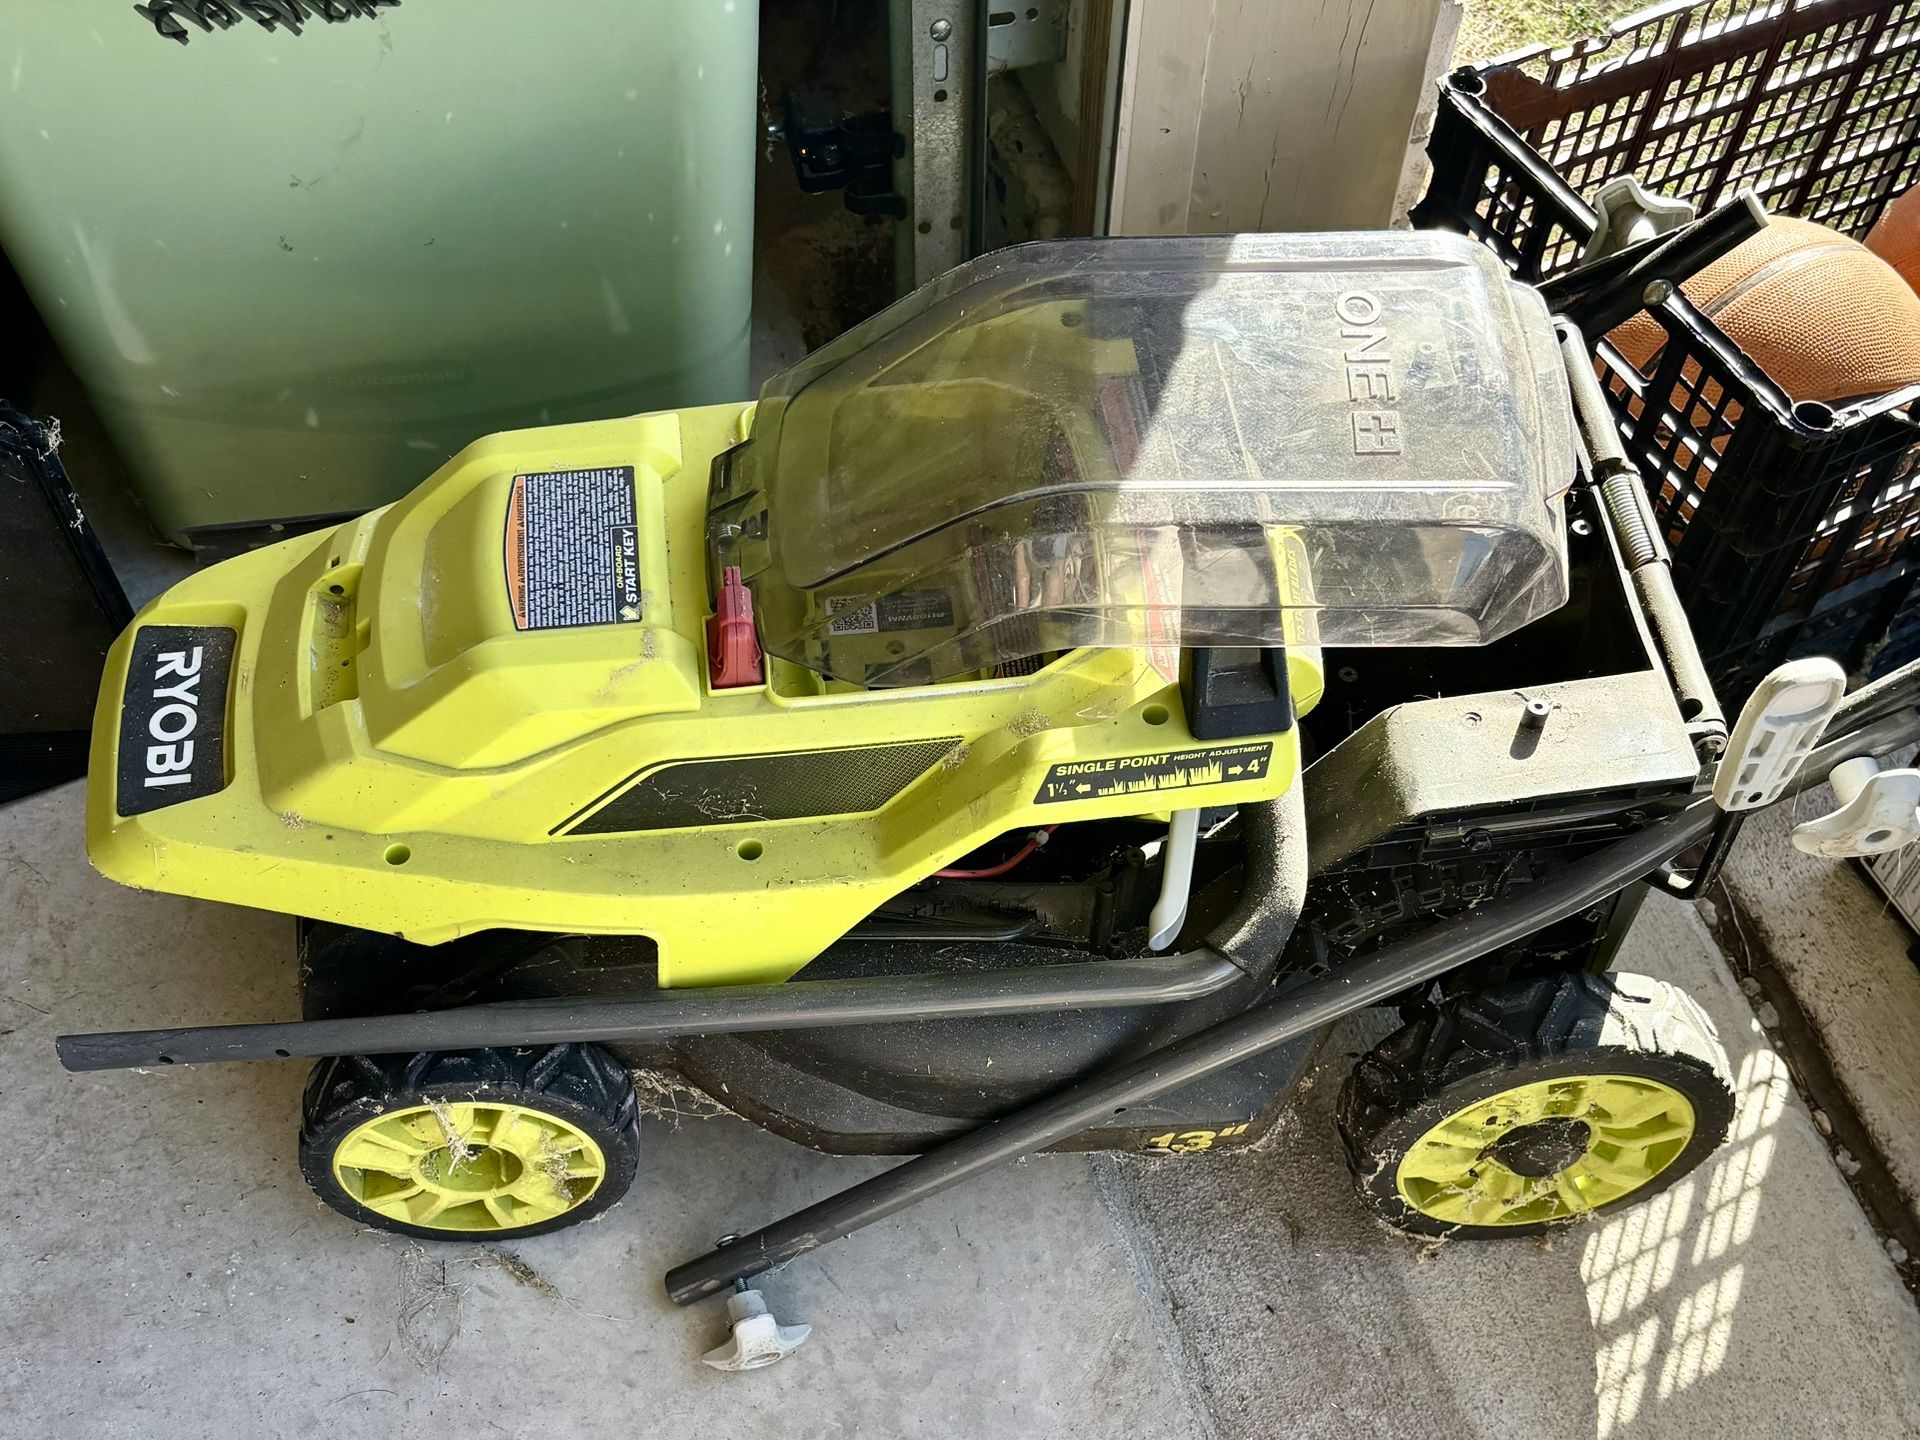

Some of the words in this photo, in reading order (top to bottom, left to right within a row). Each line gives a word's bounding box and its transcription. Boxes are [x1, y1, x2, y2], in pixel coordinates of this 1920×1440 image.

[622, 528, 634, 556] KEY
[615, 545, 624, 588] ON-BOARD
[624, 559, 637, 603] START
[144, 646, 204, 788] RYOBI
[1056, 759, 1116, 777] SINGLE
[1119, 754, 1170, 771] POINT
[1173, 751, 1207, 762] HEIGHT
[1209, 744, 1269, 757] ADJUSTMENT
